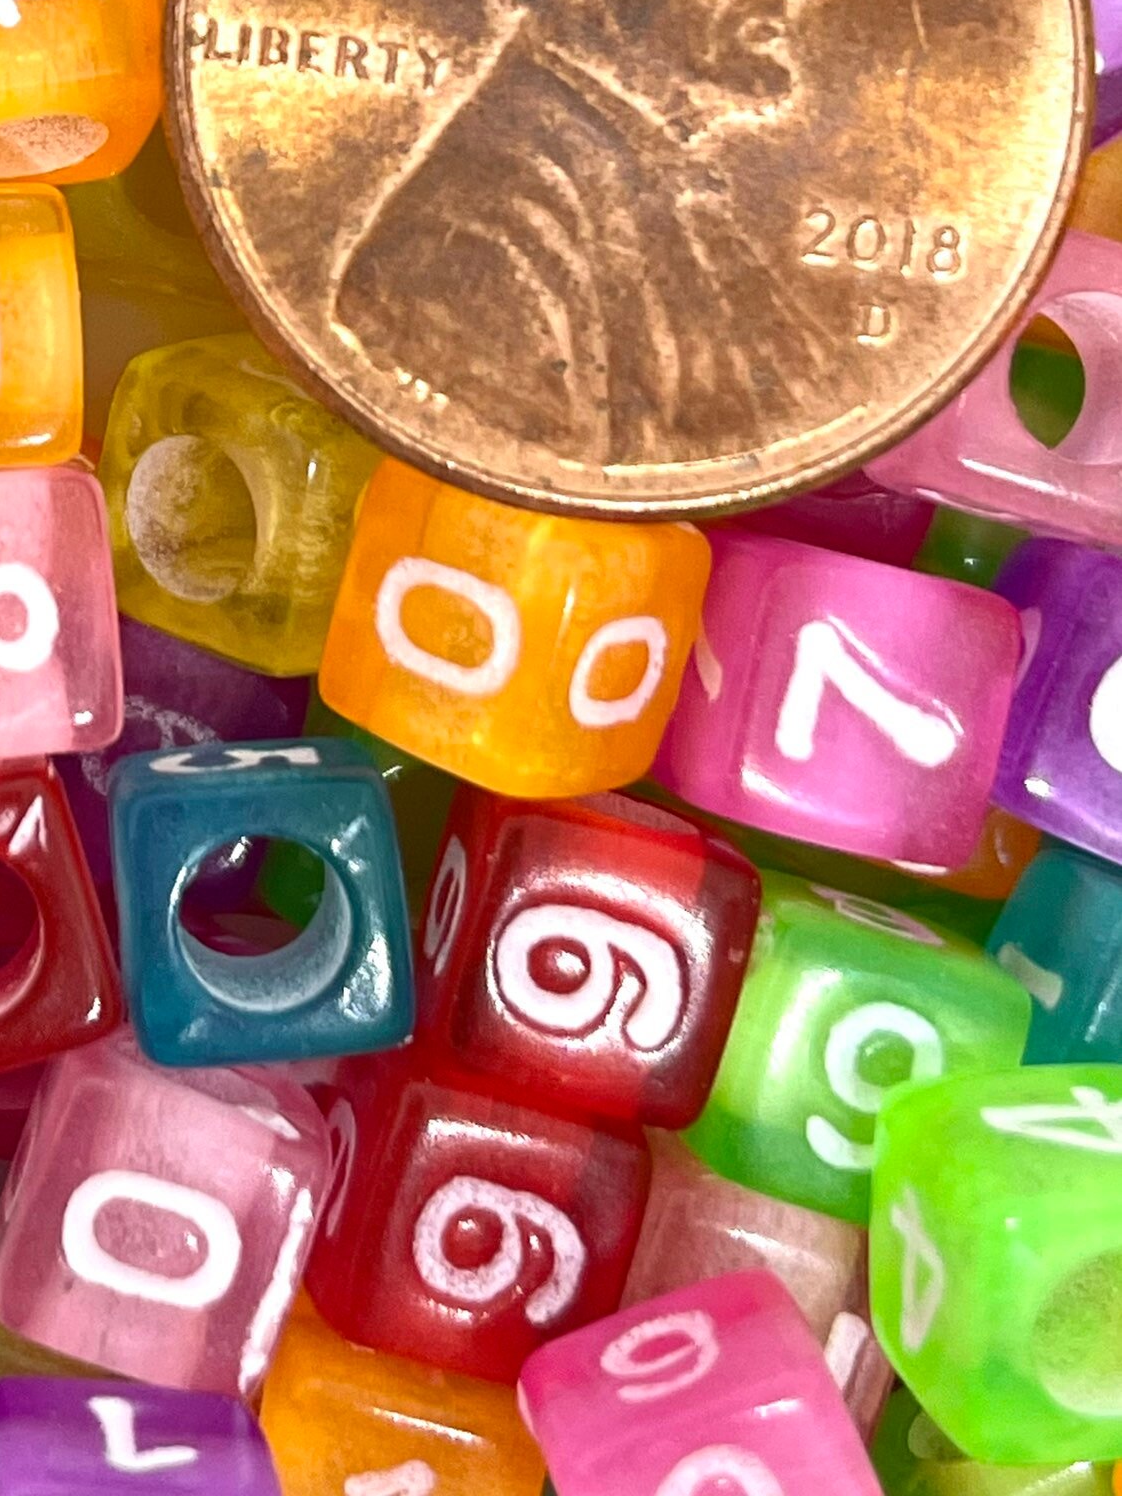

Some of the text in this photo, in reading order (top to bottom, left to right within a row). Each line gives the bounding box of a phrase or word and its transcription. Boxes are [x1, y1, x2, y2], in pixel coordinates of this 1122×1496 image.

[203, 16, 455, 92] LIBERTY
[801, 207, 967, 282] 2018
[856, 302, 899, 346] D
[376, 558, 520, 696] 0
[569, 616, 667, 727] 0
[773, 619, 960, 769] 7
[63, 1170, 241, 1310] 0
